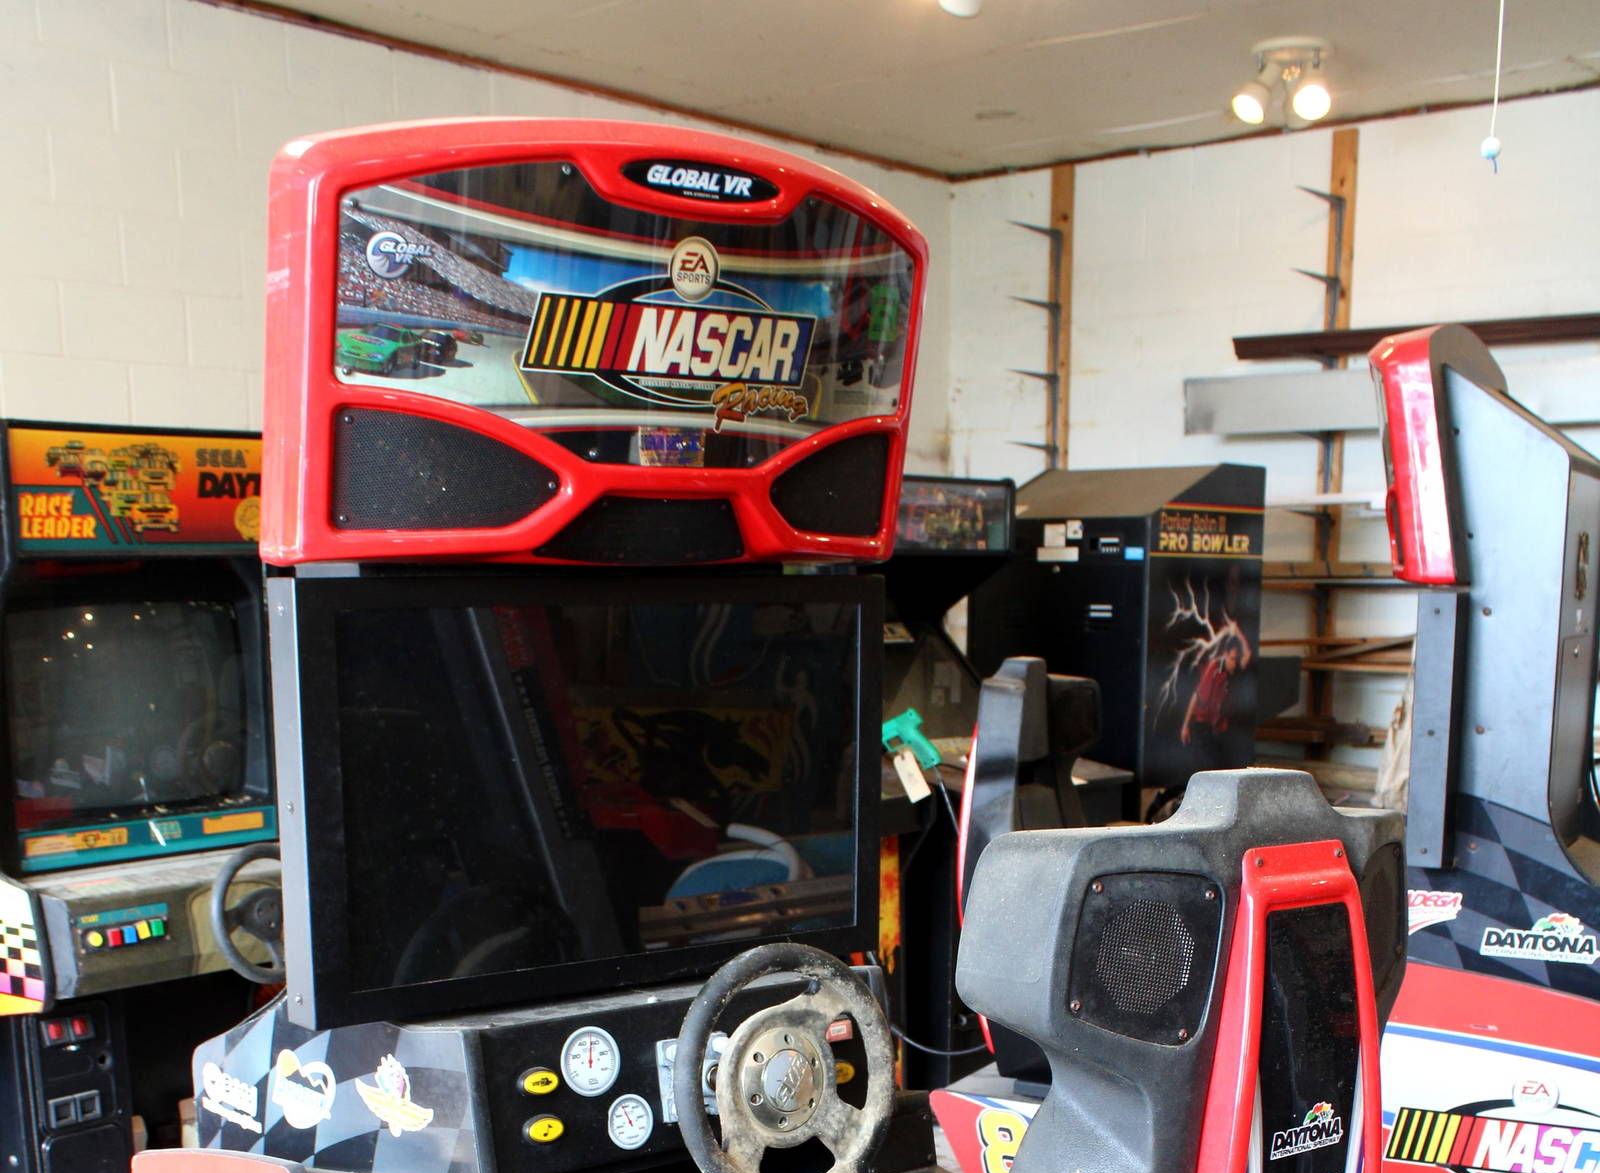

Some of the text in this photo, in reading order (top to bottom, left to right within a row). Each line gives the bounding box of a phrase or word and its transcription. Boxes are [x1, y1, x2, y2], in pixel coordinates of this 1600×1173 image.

[646, 164, 752, 197] GLOBAL VR
[379, 240, 432, 257] GLOBAL
[395, 252, 414, 264] VR
[679, 251, 709, 274] EA
[676, 271, 711, 285] SPORTS
[627, 307, 799, 382] NASCAR
[712, 382, 808, 433] Racing
[196, 448, 247, 468] SEGA
[18, 492, 73, 516] RACE
[20, 514, 97, 539] LEADER
[1160, 511, 1191, 531] Parker
[1159, 532, 1250, 553] PRO BOWLER
[1484, 930, 1595, 955] DAYTONA
[1521, 1080, 1550, 1097] EA
[1272, 1117, 1341, 1152] DAYTONA
